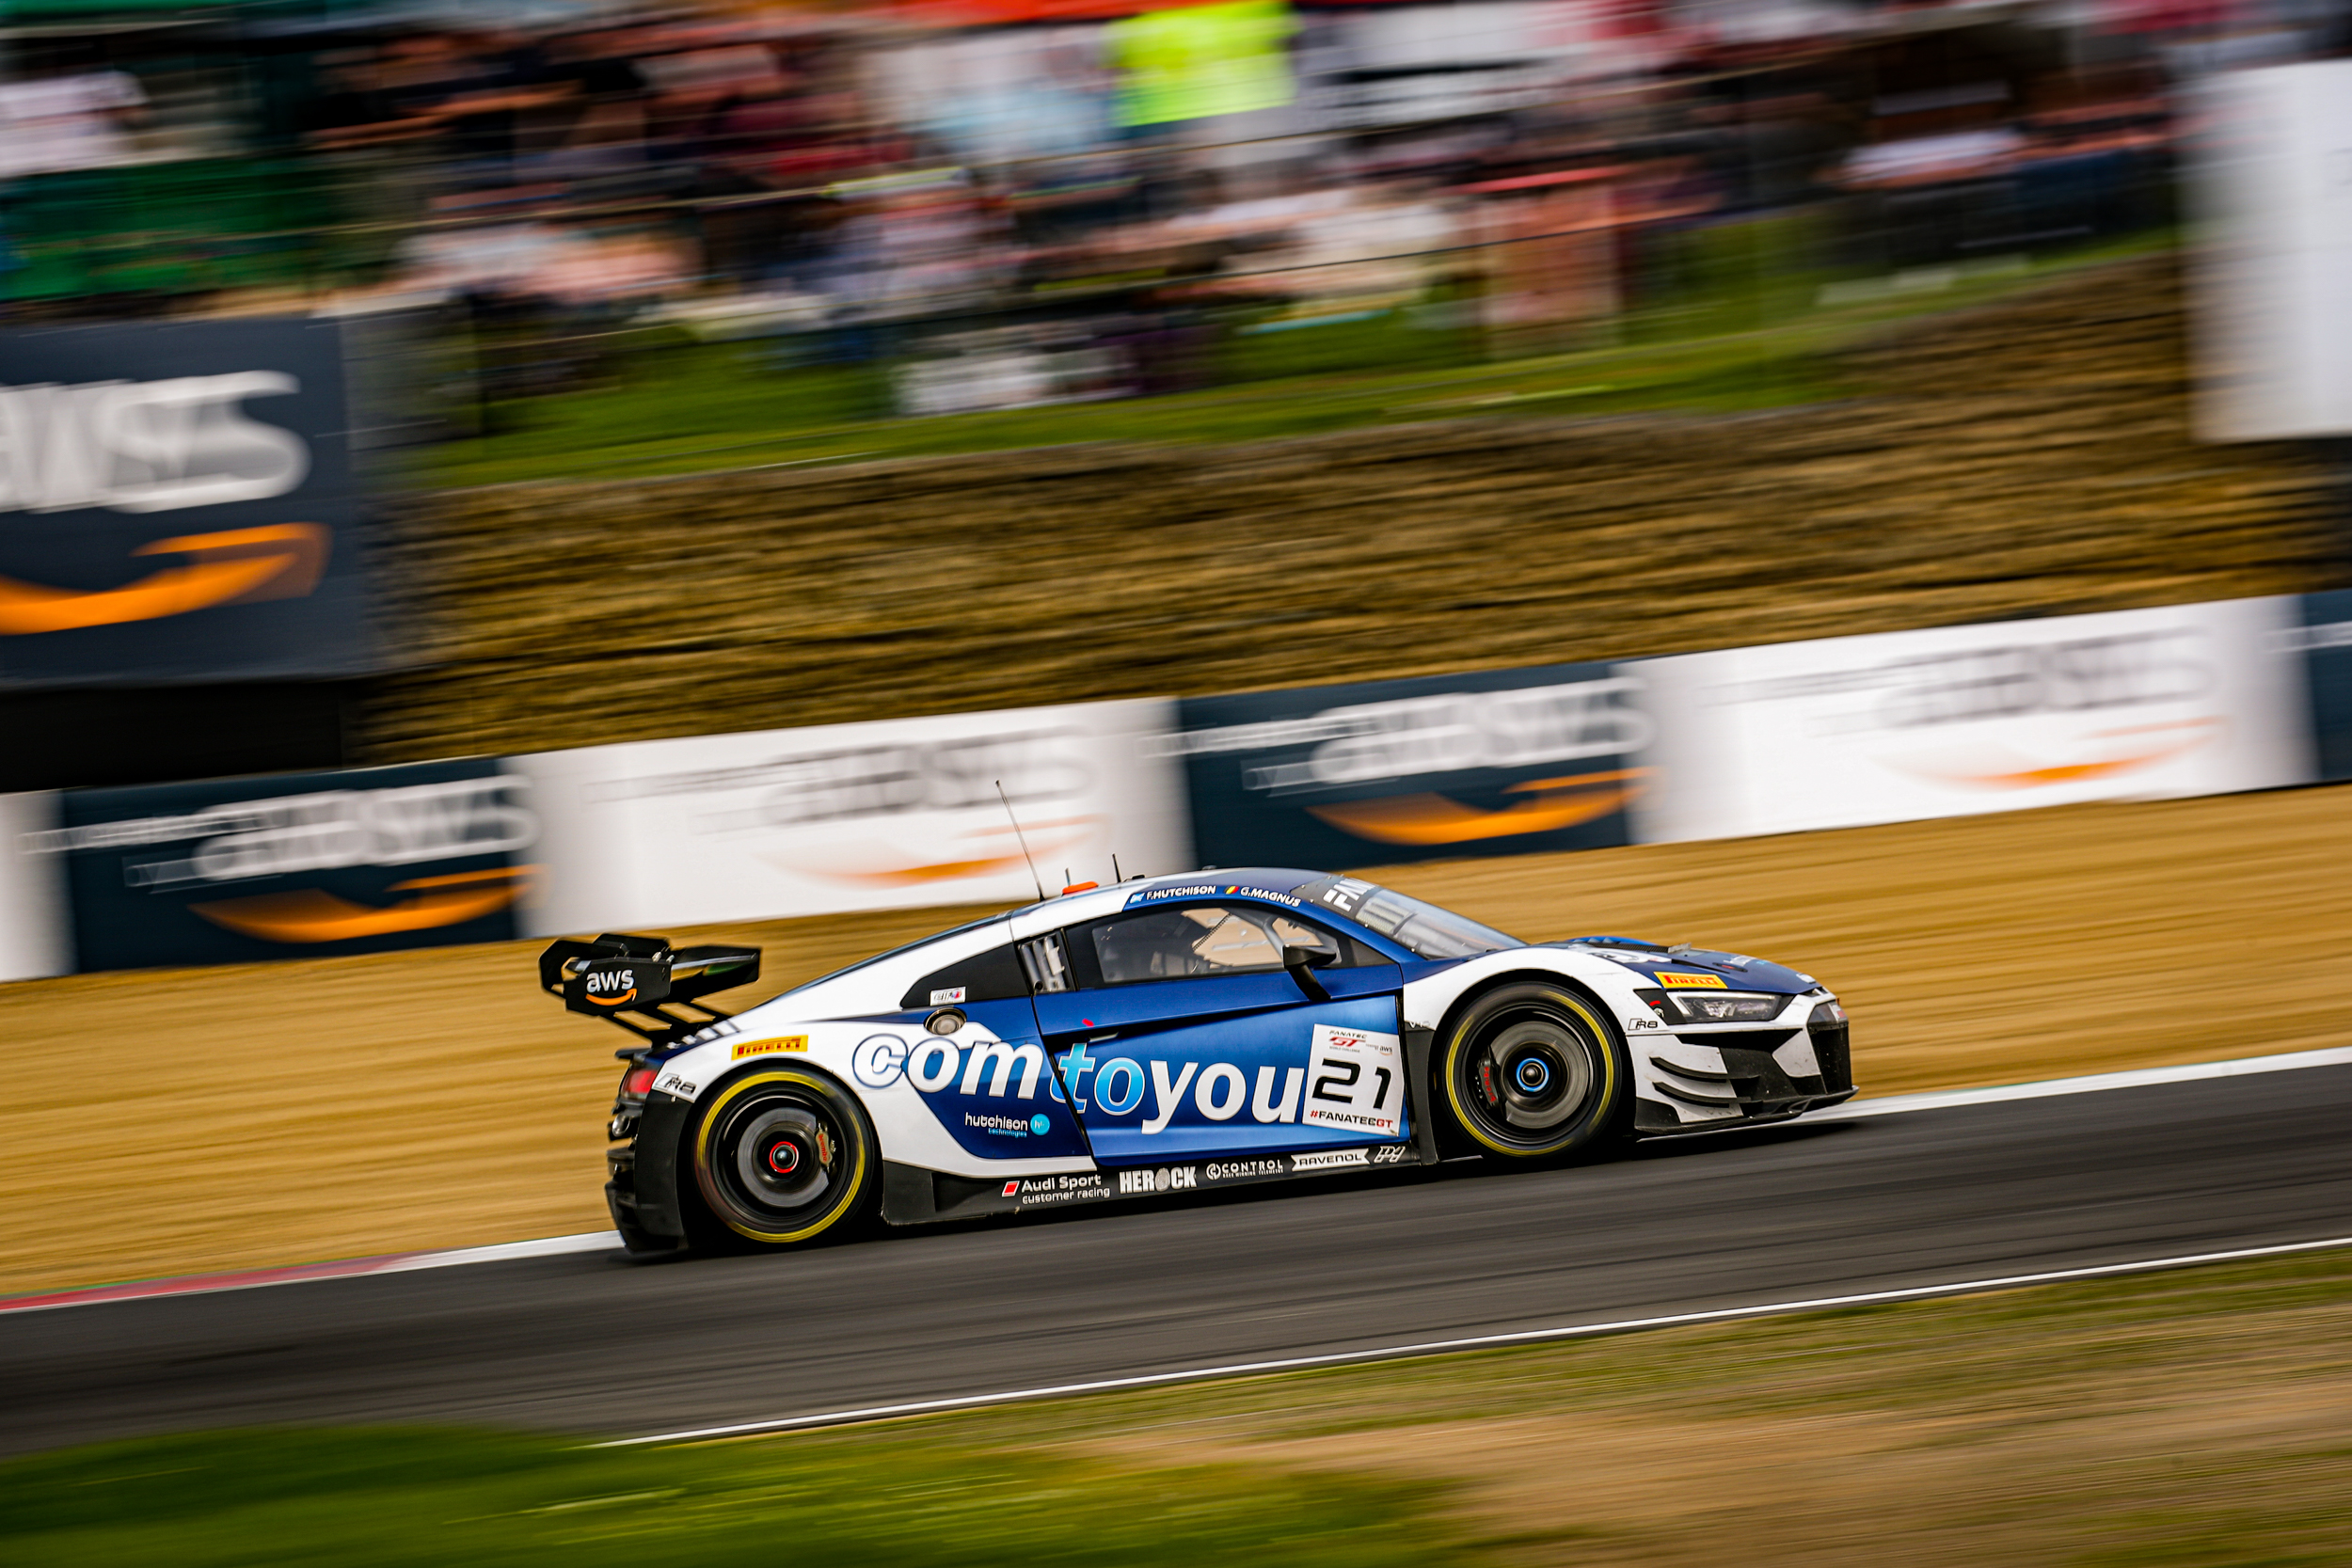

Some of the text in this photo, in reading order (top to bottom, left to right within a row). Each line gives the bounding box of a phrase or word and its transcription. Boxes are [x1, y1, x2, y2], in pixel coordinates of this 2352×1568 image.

[1146, 885, 1216, 900] F.HUTCHISON
[1240, 886, 1301, 907] G.MAGNUS
[586, 969, 635, 993] aws
[1664, 974, 1720, 987] PIRELLI
[1329, 1030, 1367, 1039] FANATEC
[1311, 1057, 1391, 1110] 21
[1310, 1110, 1393, 1128] #FANATECGT
[1222, 1159, 1283, 1174] CONTROL
[1299, 1153, 1362, 1166] RAVENOL
[1021, 1174, 1102, 1193] Audi Sport
[1022, 1187, 1110, 1205] customer racing
